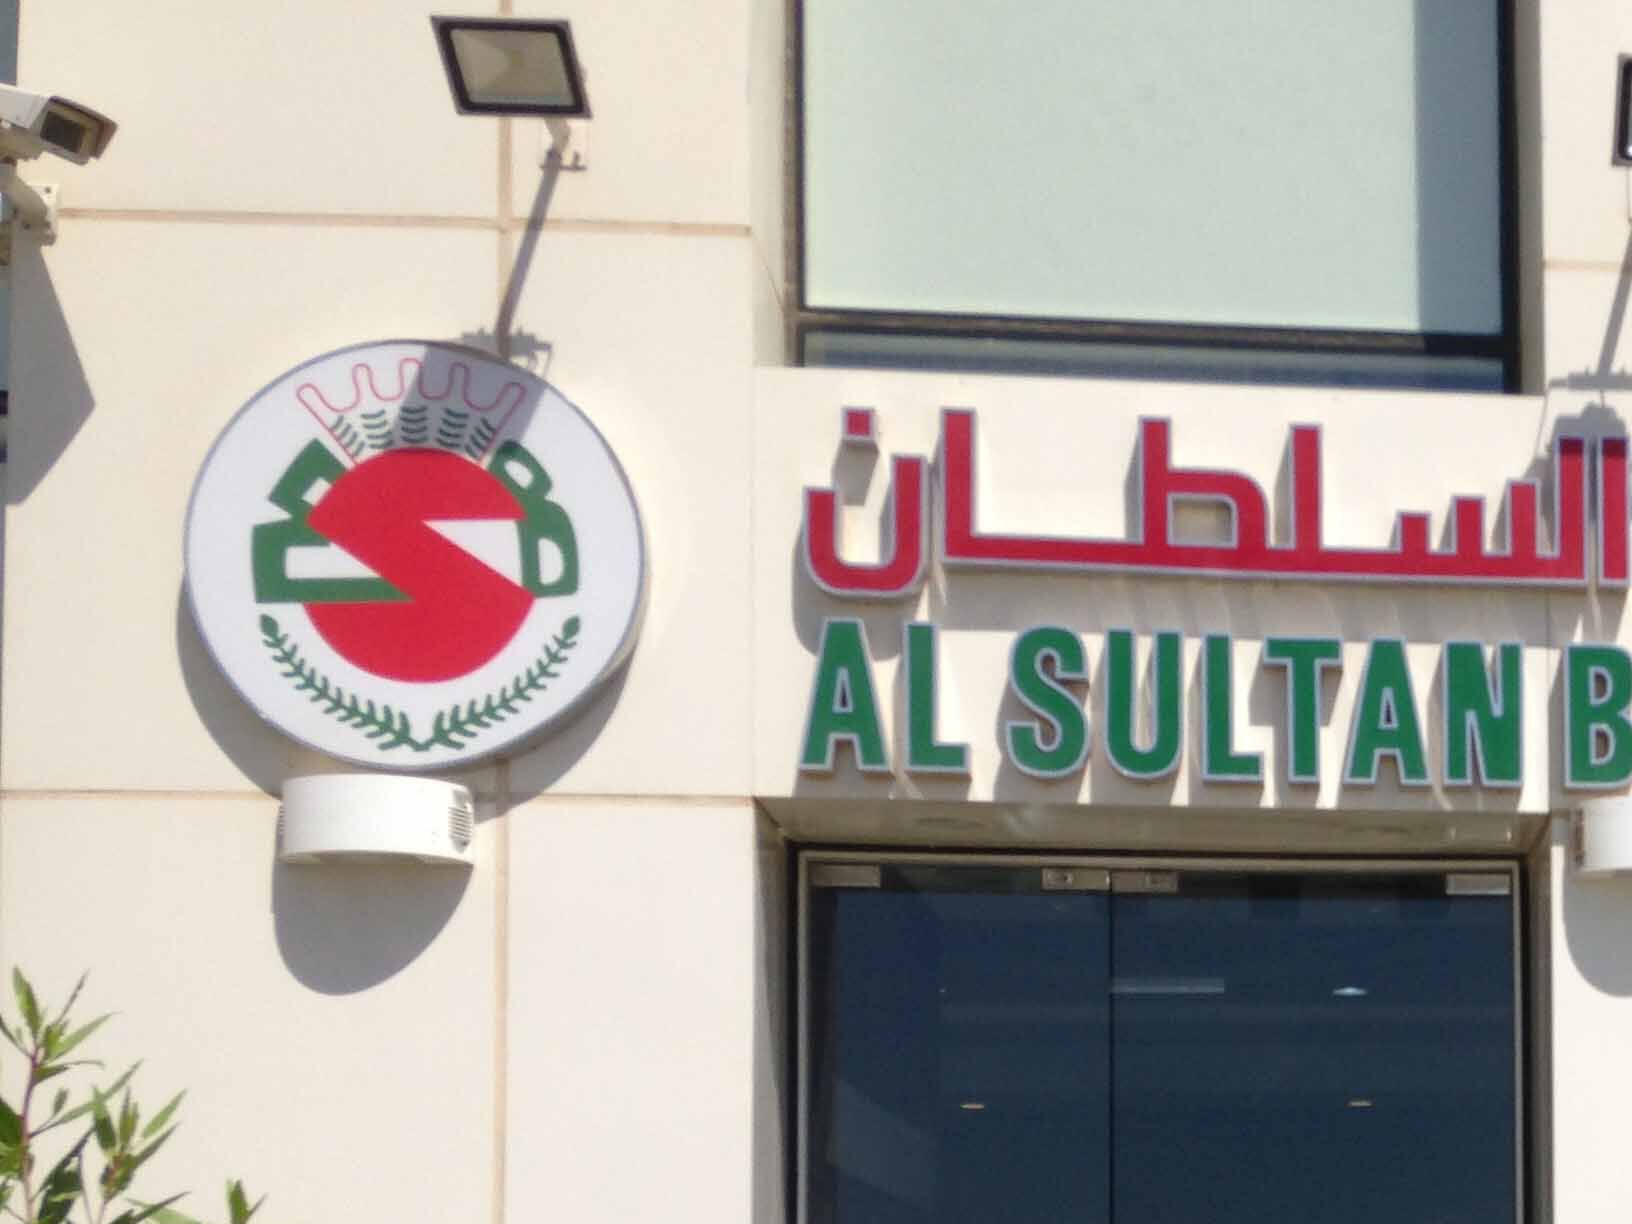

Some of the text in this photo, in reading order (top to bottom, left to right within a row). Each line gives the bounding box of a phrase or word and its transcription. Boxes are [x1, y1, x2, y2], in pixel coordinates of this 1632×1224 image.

[803, 407, 1630, 598] السلطان
[801, 618, 971, 775] AL
[1004, 625, 1525, 788] SULTAN
